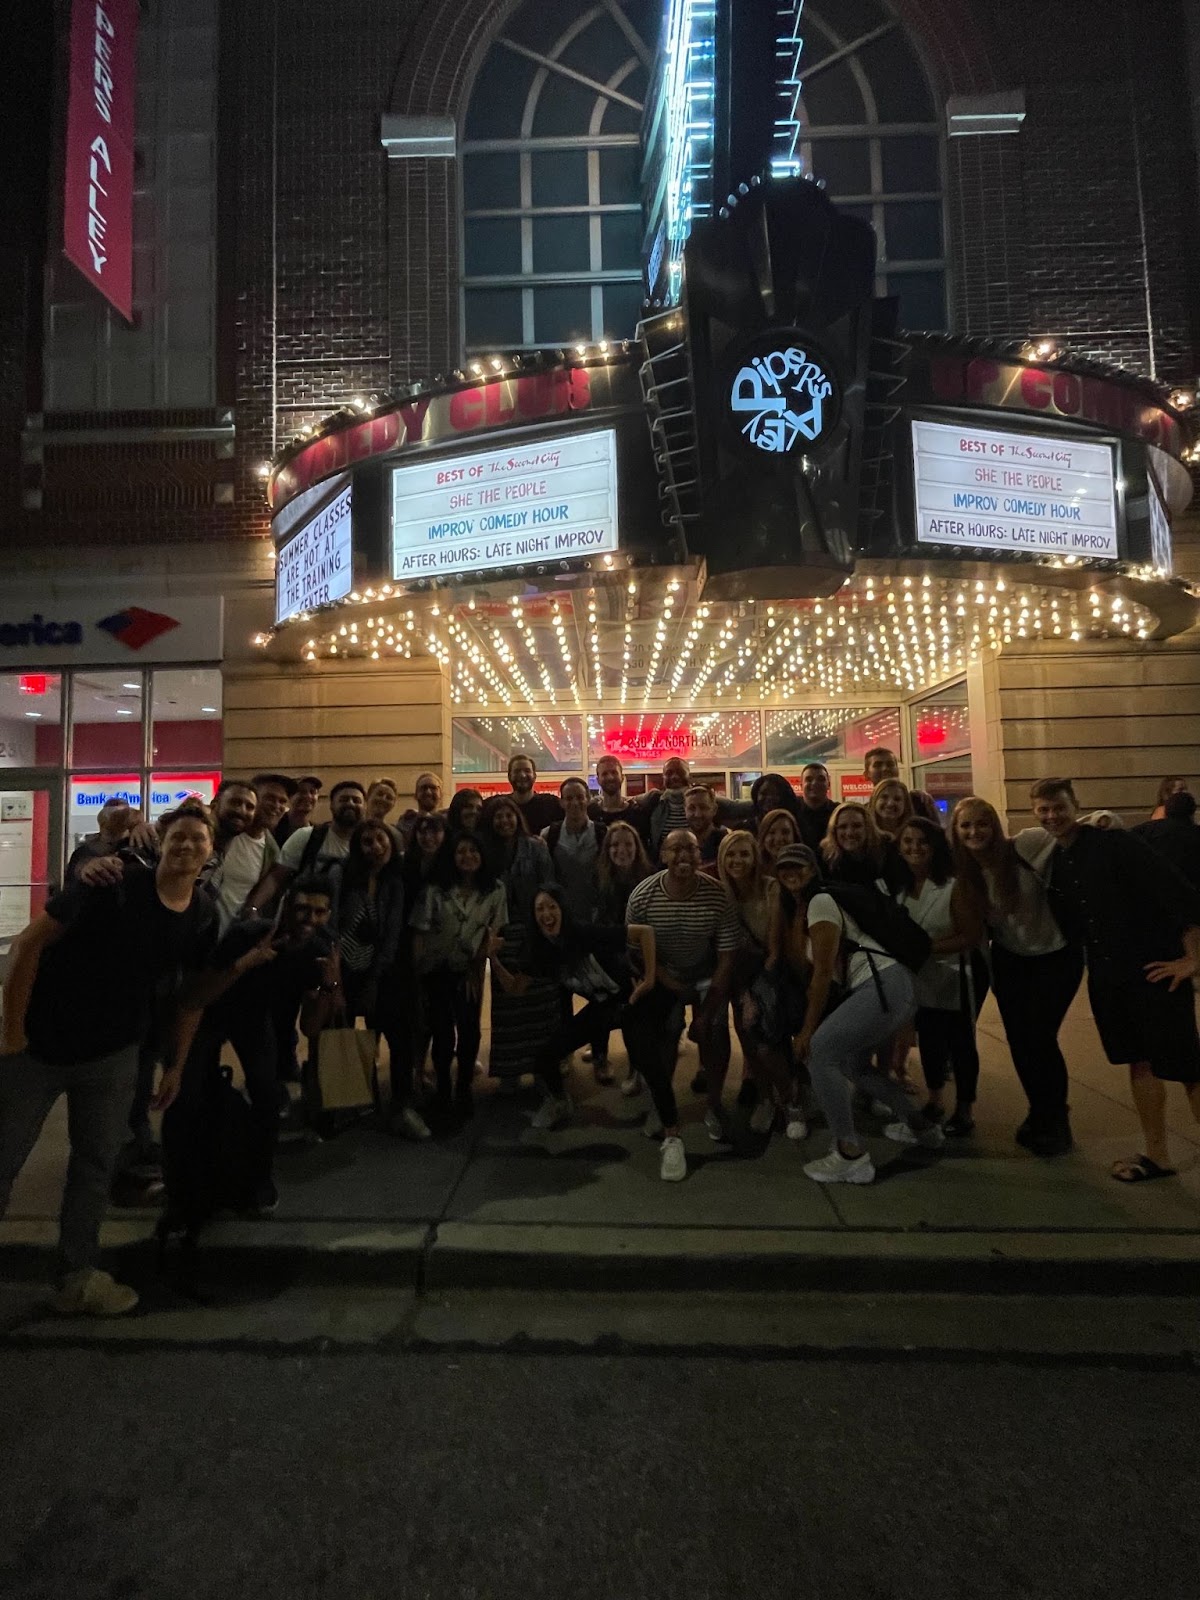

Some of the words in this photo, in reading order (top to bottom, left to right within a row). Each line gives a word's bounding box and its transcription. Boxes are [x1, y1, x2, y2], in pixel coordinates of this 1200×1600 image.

[94, 0, 114, 124] PERS
[88, 136, 111, 274] ALLEY
[960, 439, 987, 454] BEST
[991, 444, 1005, 456] OF
[437, 469, 465, 485] BEST
[469, 465, 484, 478] OF
[488, 462, 507, 472] The
[540, 451, 562, 467] City
[975, 468, 997, 483] SHE
[1001, 471, 1023, 486] THE
[1026, 474, 1063, 491] PEOPLE
[450, 492, 473, 509] SHE
[479, 488, 500, 505] THE
[505, 480, 547, 500] PEOPLE
[953, 493, 999, 512] IMPROV
[1003, 499, 1047, 517] COMEDY
[1051, 503, 1081, 521] HOUR
[280, 532, 309, 572] SUMMER
[314, 493, 352, 541] CLASSES
[428, 518, 476, 540] IMPROV
[480, 511, 528, 531] COMEDY
[533, 505, 569, 524] HOUR
[929, 519, 965, 538] AFTER
[968, 523, 1008, 540] HOURS:
[1012, 527, 1036, 543] LATE
[1039, 530, 1068, 546] NIGHT
[1072, 533, 1111, 550] IMPROV
[286, 561, 300, 587] ARE
[324, 530, 337, 557] AT
[402, 553, 437, 570] AFTER
[440, 547, 481, 564] HOURS:
[486, 542, 513, 559] LATE
[516, 536, 550, 555] NIGHT
[555, 530, 604, 547] IMPROV
[286, 583, 300, 607] THE
[303, 550, 341, 596] TRAINING
[300, 584, 330, 610] CENTER
[665, 734, 698, 747] NORTH
[77, 793, 106, 805] Bank
[121, 792, 170, 805] Amica
